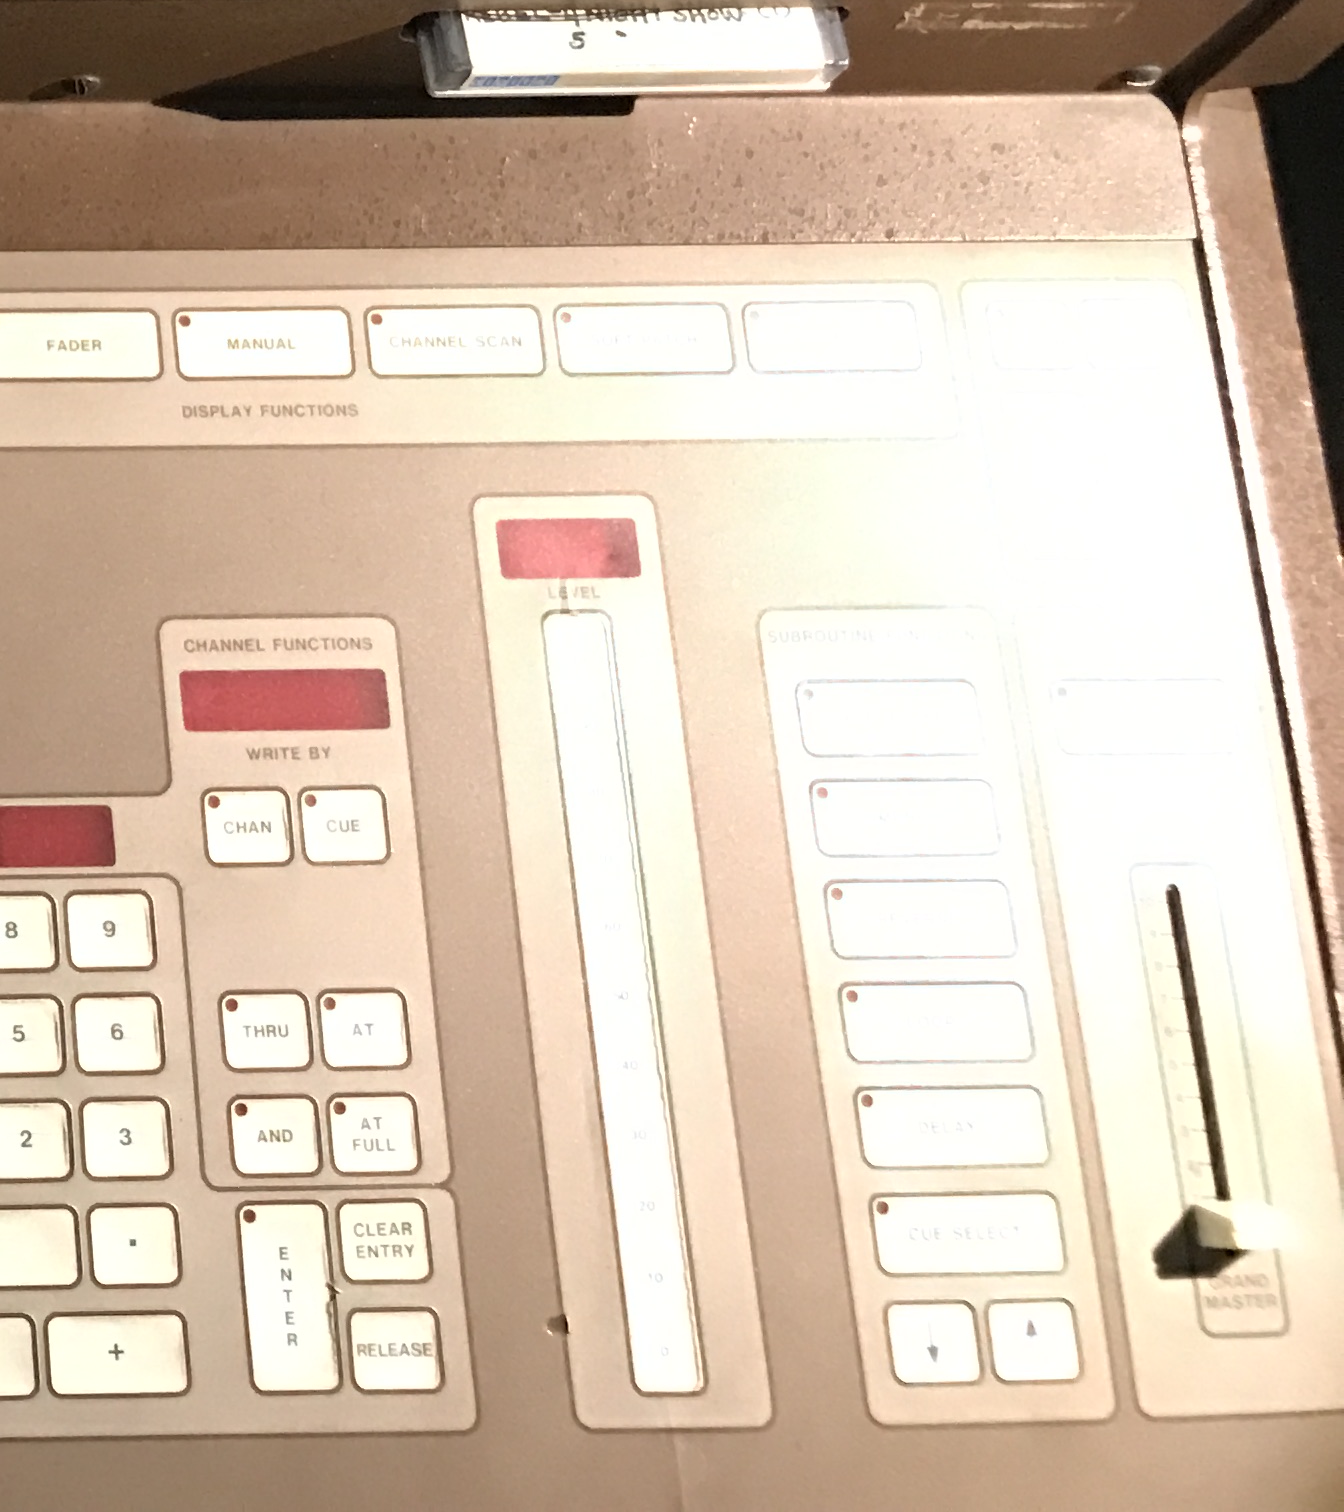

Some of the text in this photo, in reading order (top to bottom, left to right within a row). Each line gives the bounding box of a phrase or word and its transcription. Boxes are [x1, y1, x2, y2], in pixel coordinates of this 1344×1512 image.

[46, 340, 102, 352] FADER
[227, 338, 295, 350] MANUAL
[390, 336, 522, 347] CHANNEL SCAN
[182, 404, 358, 419] DISPLAY FUNCTIONS
[548, 586, 600, 598] LEVEL
[184, 637, 373, 653] CHANNEL FUNCTIONS
[246, 746, 330, 760] WRITE BY
[224, 821, 271, 834] CHAN
[327, 820, 360, 832] CUE
[5, 922, 18, 938] 8
[103, 921, 115, 937] 9
[13, 1025, 25, 1042] 5
[111, 1023, 123, 1040] 6
[243, 1025, 288, 1037] THRU
[353, 1023, 373, 1035] AT
[361, 1117, 382, 1130] AT
[20, 1130, 32, 1147] 2
[120, 1128, 132, 1145] 3
[258, 1129, 293, 1142] AND
[353, 1139, 395, 1152] FULL
[354, 1222, 412, 1237] CLEAR
[909, 1228, 940, 1241] CUE
[356, 1244, 414, 1258] ENTRY
[279, 1247, 297, 1346] ENTER
[1204, 1293, 1278, 1310] MASTER
[108, 1344, 124, 1360] +
[357, 1343, 433, 1357] RELEASE
